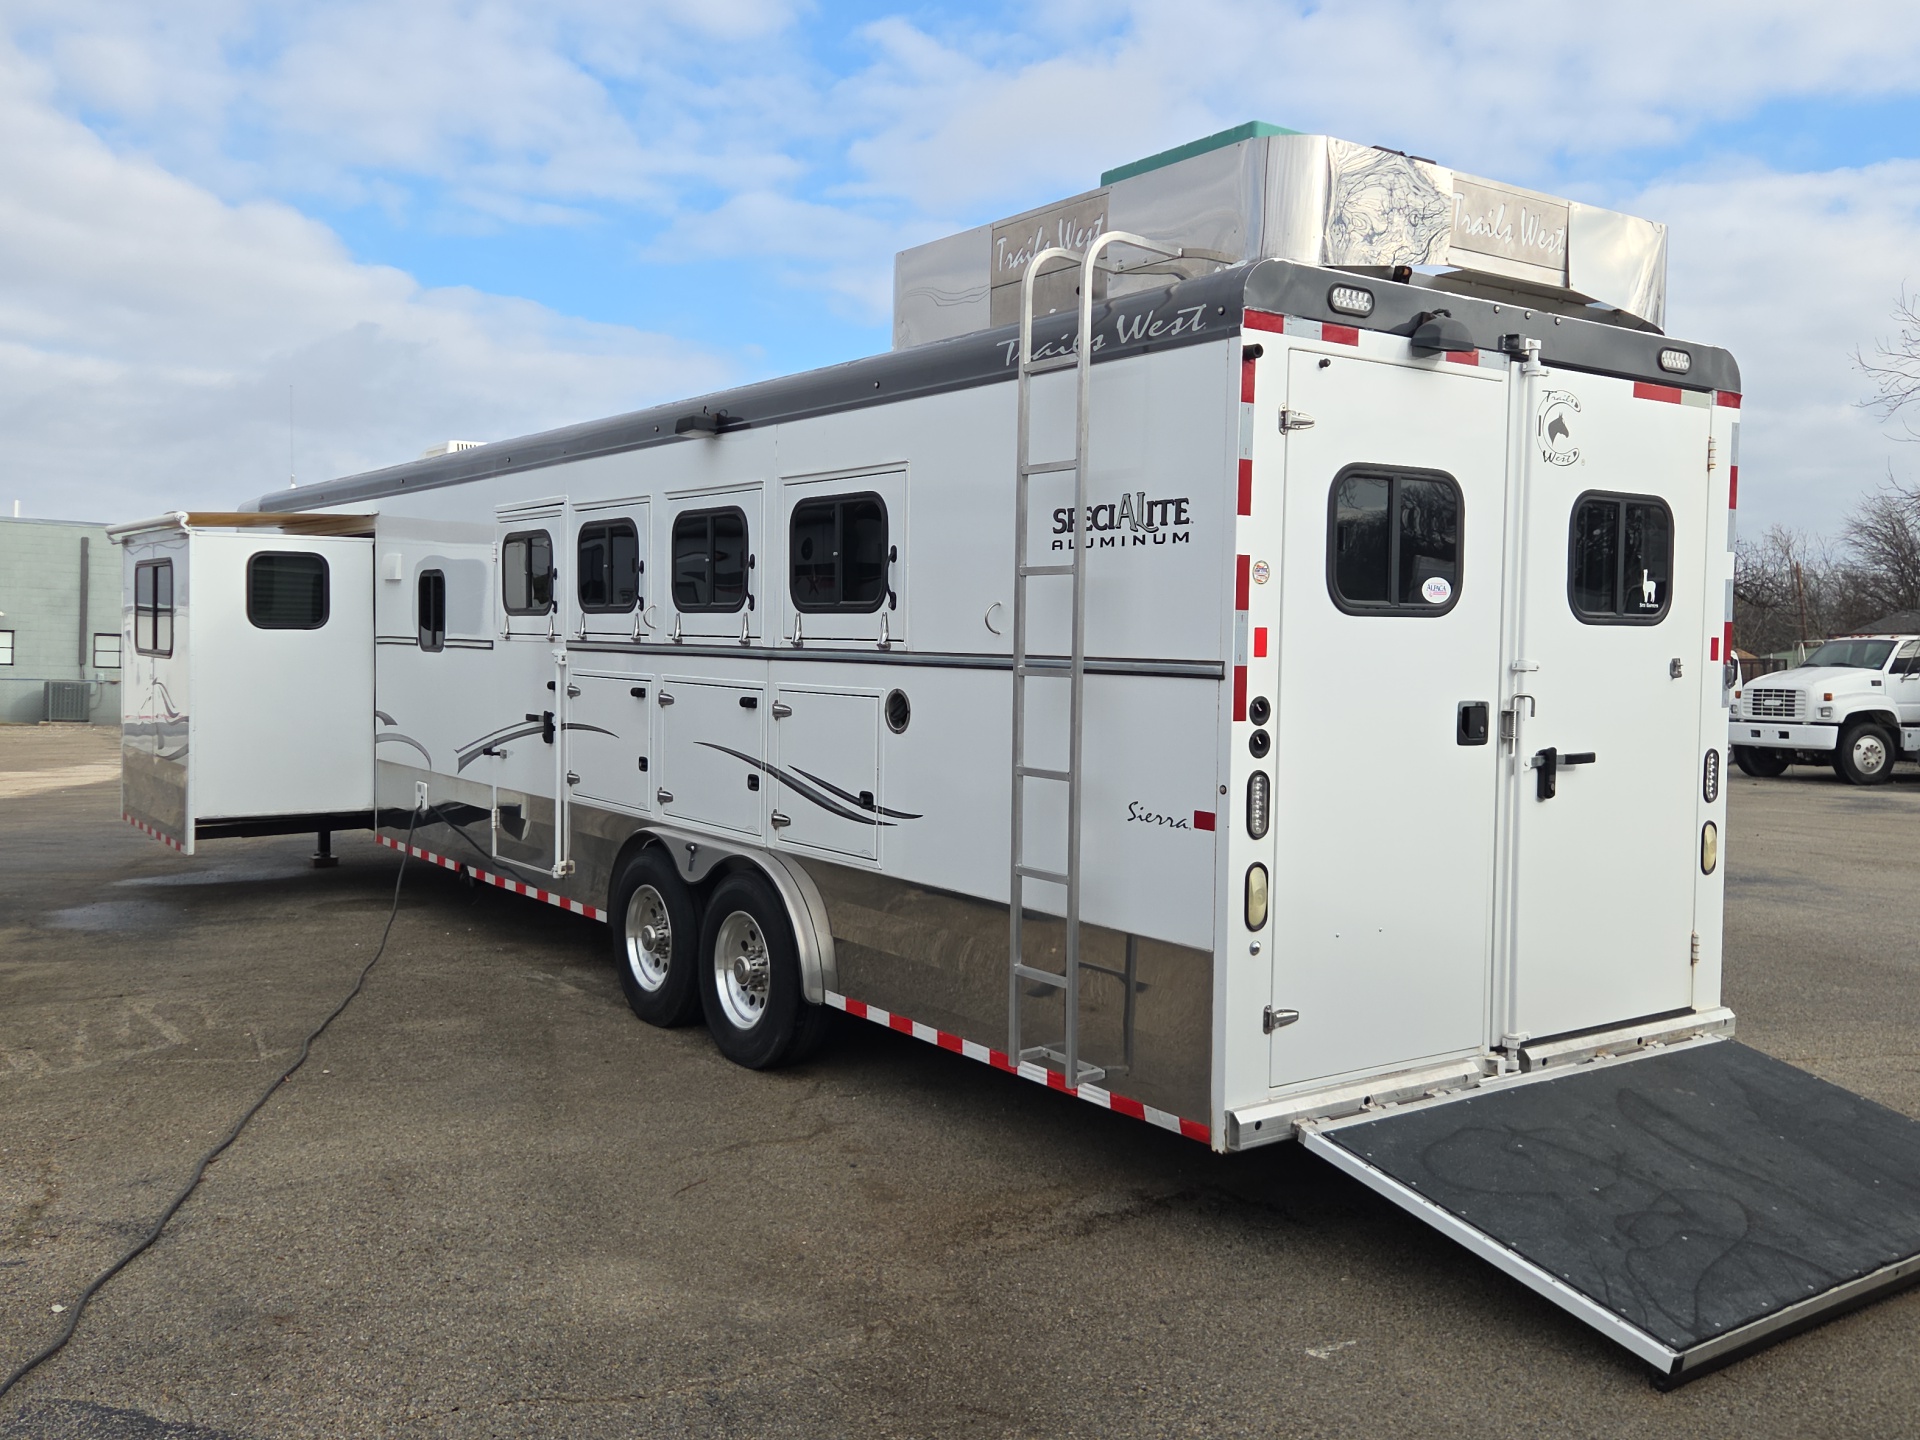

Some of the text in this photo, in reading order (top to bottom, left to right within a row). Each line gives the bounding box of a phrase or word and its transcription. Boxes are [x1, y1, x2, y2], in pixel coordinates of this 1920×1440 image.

[1058, 212, 1104, 252] West
[1451, 191, 1567, 255] Trails West
[1116, 303, 1207, 344] West
[1541, 389, 1575, 404] Trails
[1542, 450, 1572, 463] West
[1051, 532, 1190, 551] ALUMINUM
[1127, 800, 1189, 830] Sierra
